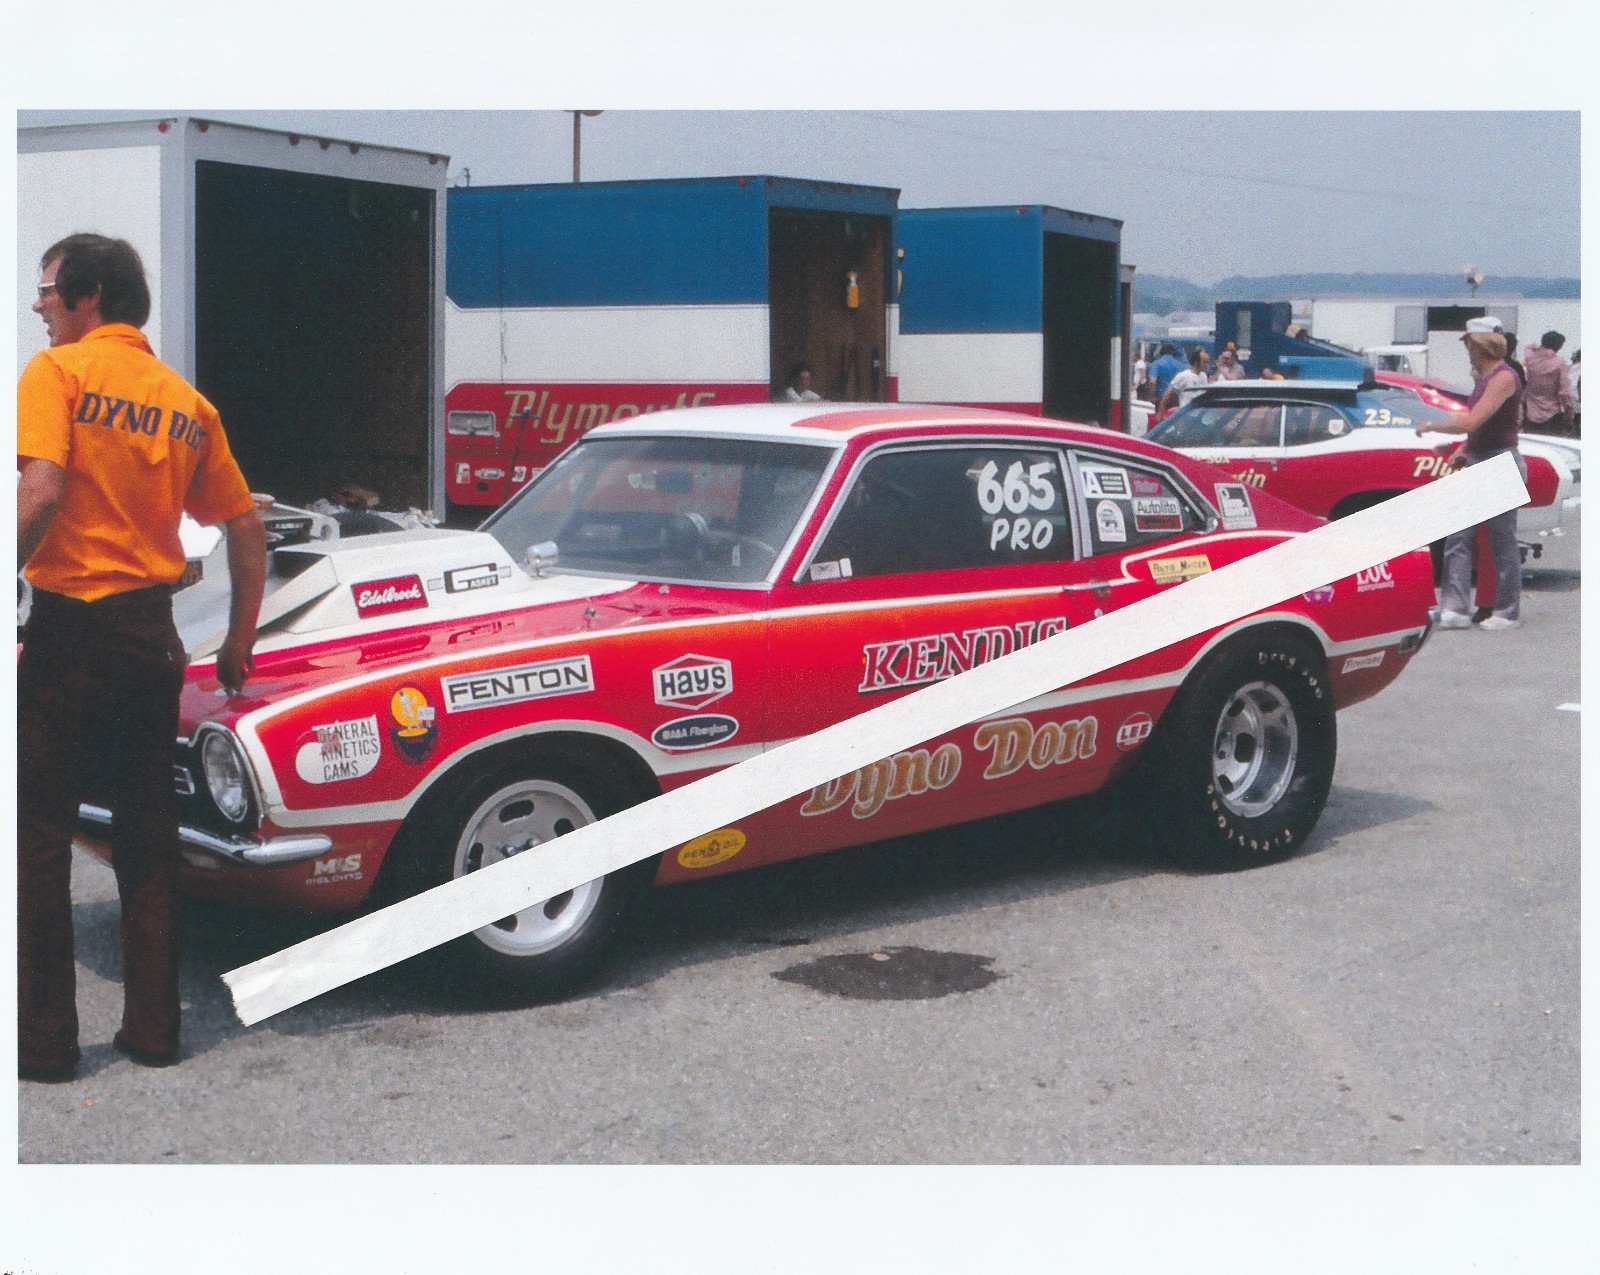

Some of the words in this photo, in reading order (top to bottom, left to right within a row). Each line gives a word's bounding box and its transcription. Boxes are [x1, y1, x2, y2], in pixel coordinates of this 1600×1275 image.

[75, 392, 162, 436] DYNO
[504, 390, 716, 444] Plymo
[1364, 408, 1391, 425] 23
[978, 460, 1056, 514] 665
[1137, 501, 1177, 515] Autolite
[990, 518, 1053, 551] PRO
[359, 584, 421, 608] Edelbrock
[448, 664, 588, 703] FENTON
[660, 666, 727, 697] Hays
[318, 721, 375, 743] GENERAL
[974, 716, 1098, 779] Don
[321, 738, 379, 762] KINETICS
[324, 761, 358, 781] CAMS
